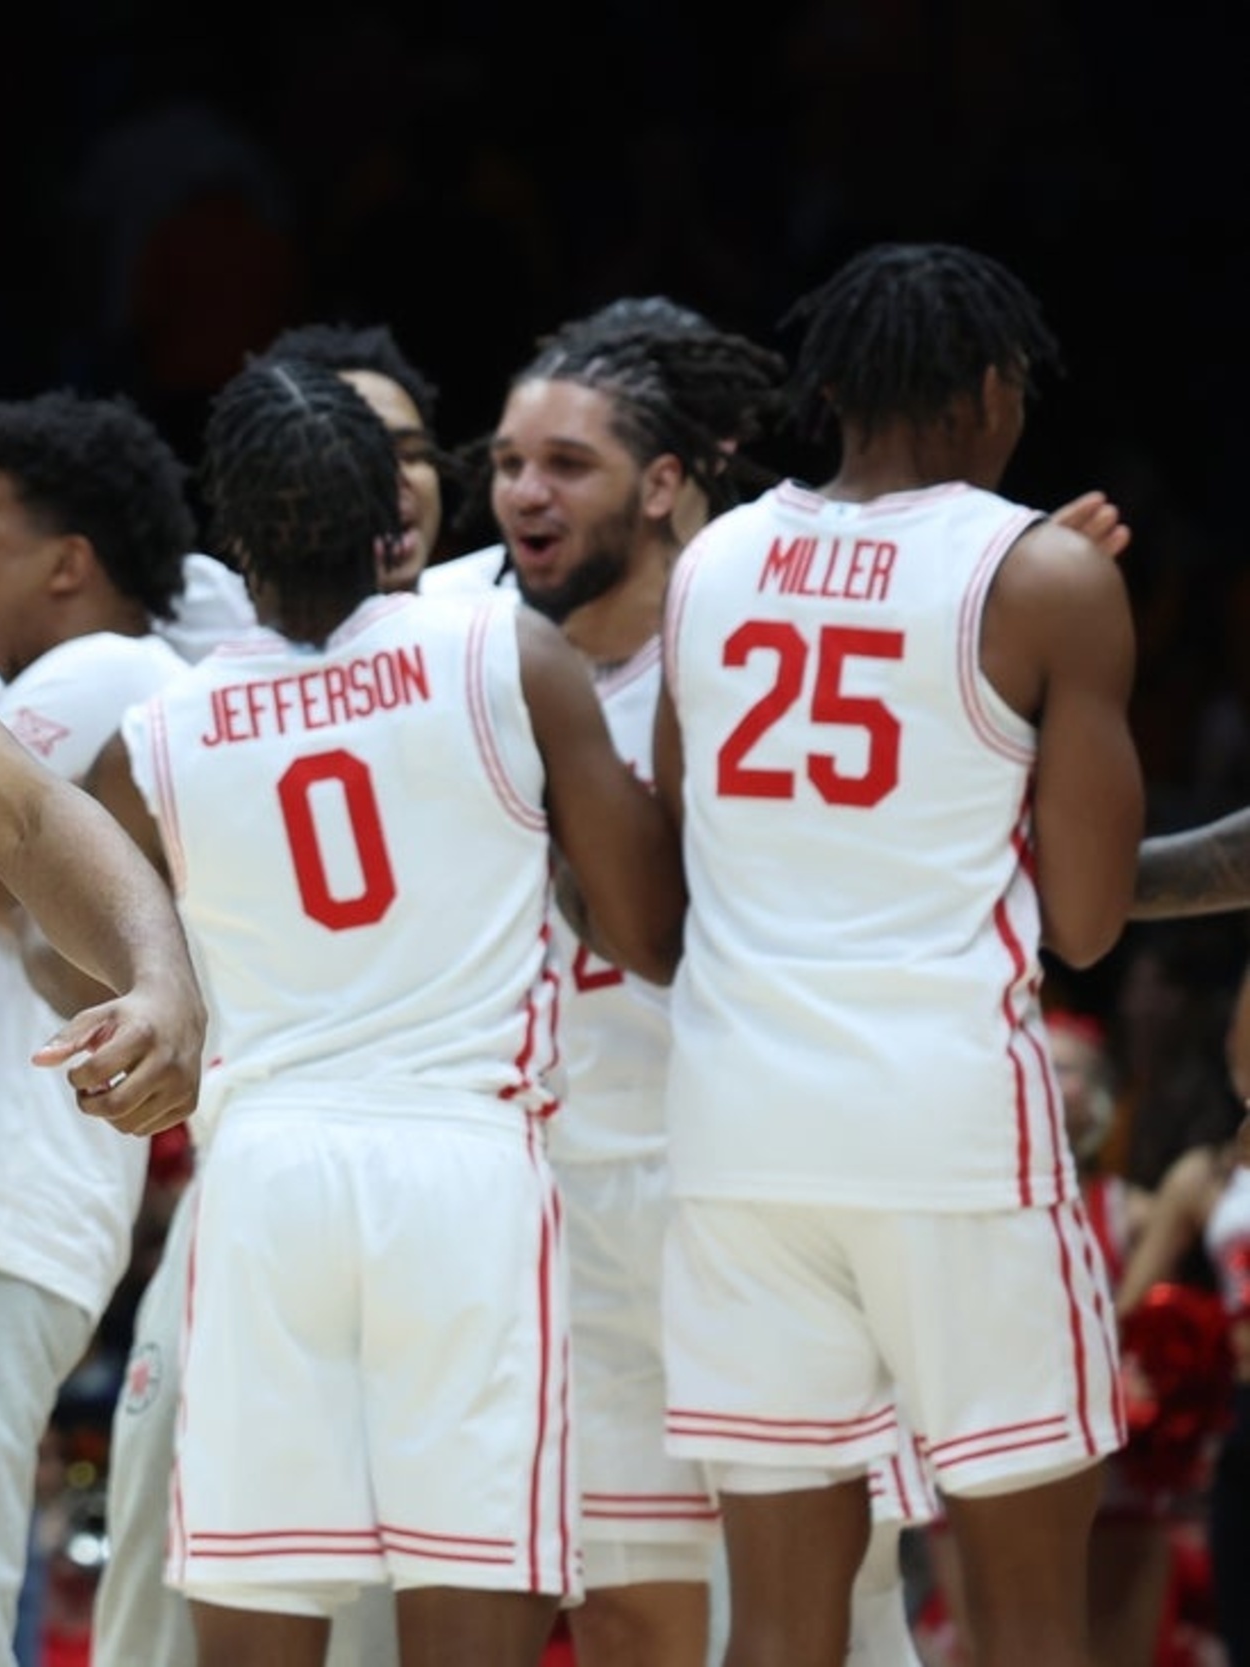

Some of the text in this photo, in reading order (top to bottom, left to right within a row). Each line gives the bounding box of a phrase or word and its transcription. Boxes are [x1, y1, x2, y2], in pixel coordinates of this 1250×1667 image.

[758, 537, 898, 601] MILLER
[202, 643, 431, 747] JEFFERSON
[716, 618, 905, 810] 25
[275, 748, 398, 933] 0
